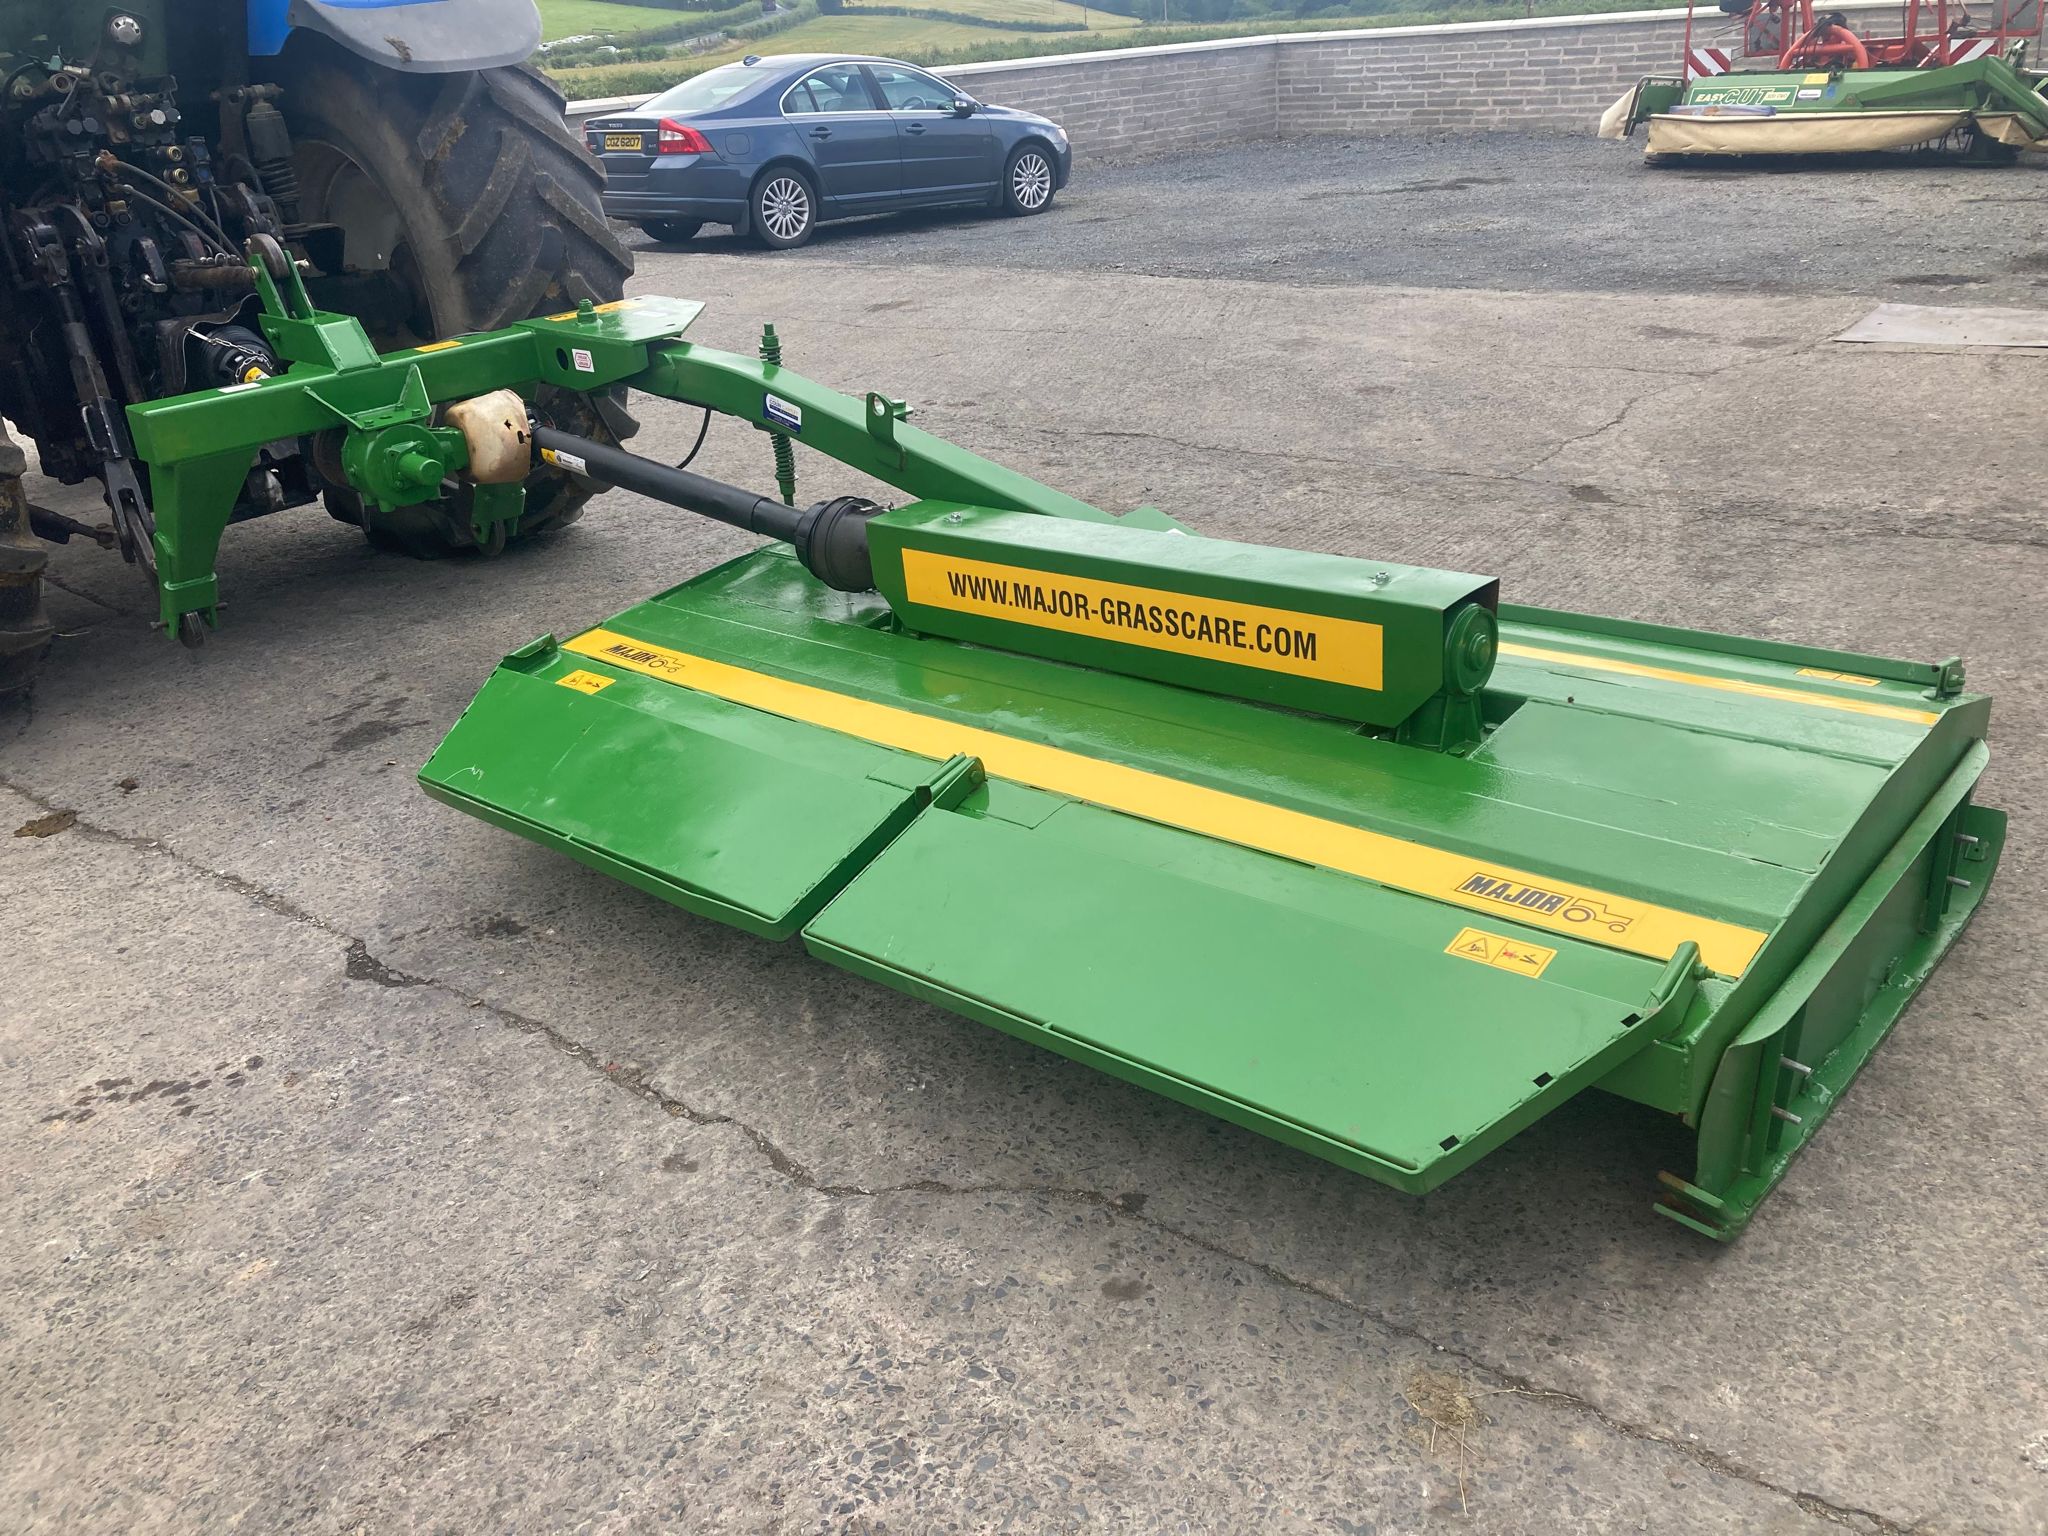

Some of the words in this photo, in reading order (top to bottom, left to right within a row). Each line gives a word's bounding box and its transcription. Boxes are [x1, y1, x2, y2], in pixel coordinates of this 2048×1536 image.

[621, 137, 640, 147] 6207
[947, 571, 1317, 661] WWW.MAJOR-GRASSCARE.COM
[605, 644, 658, 663] MAJOR
[1461, 875, 1566, 912] MAJOR
